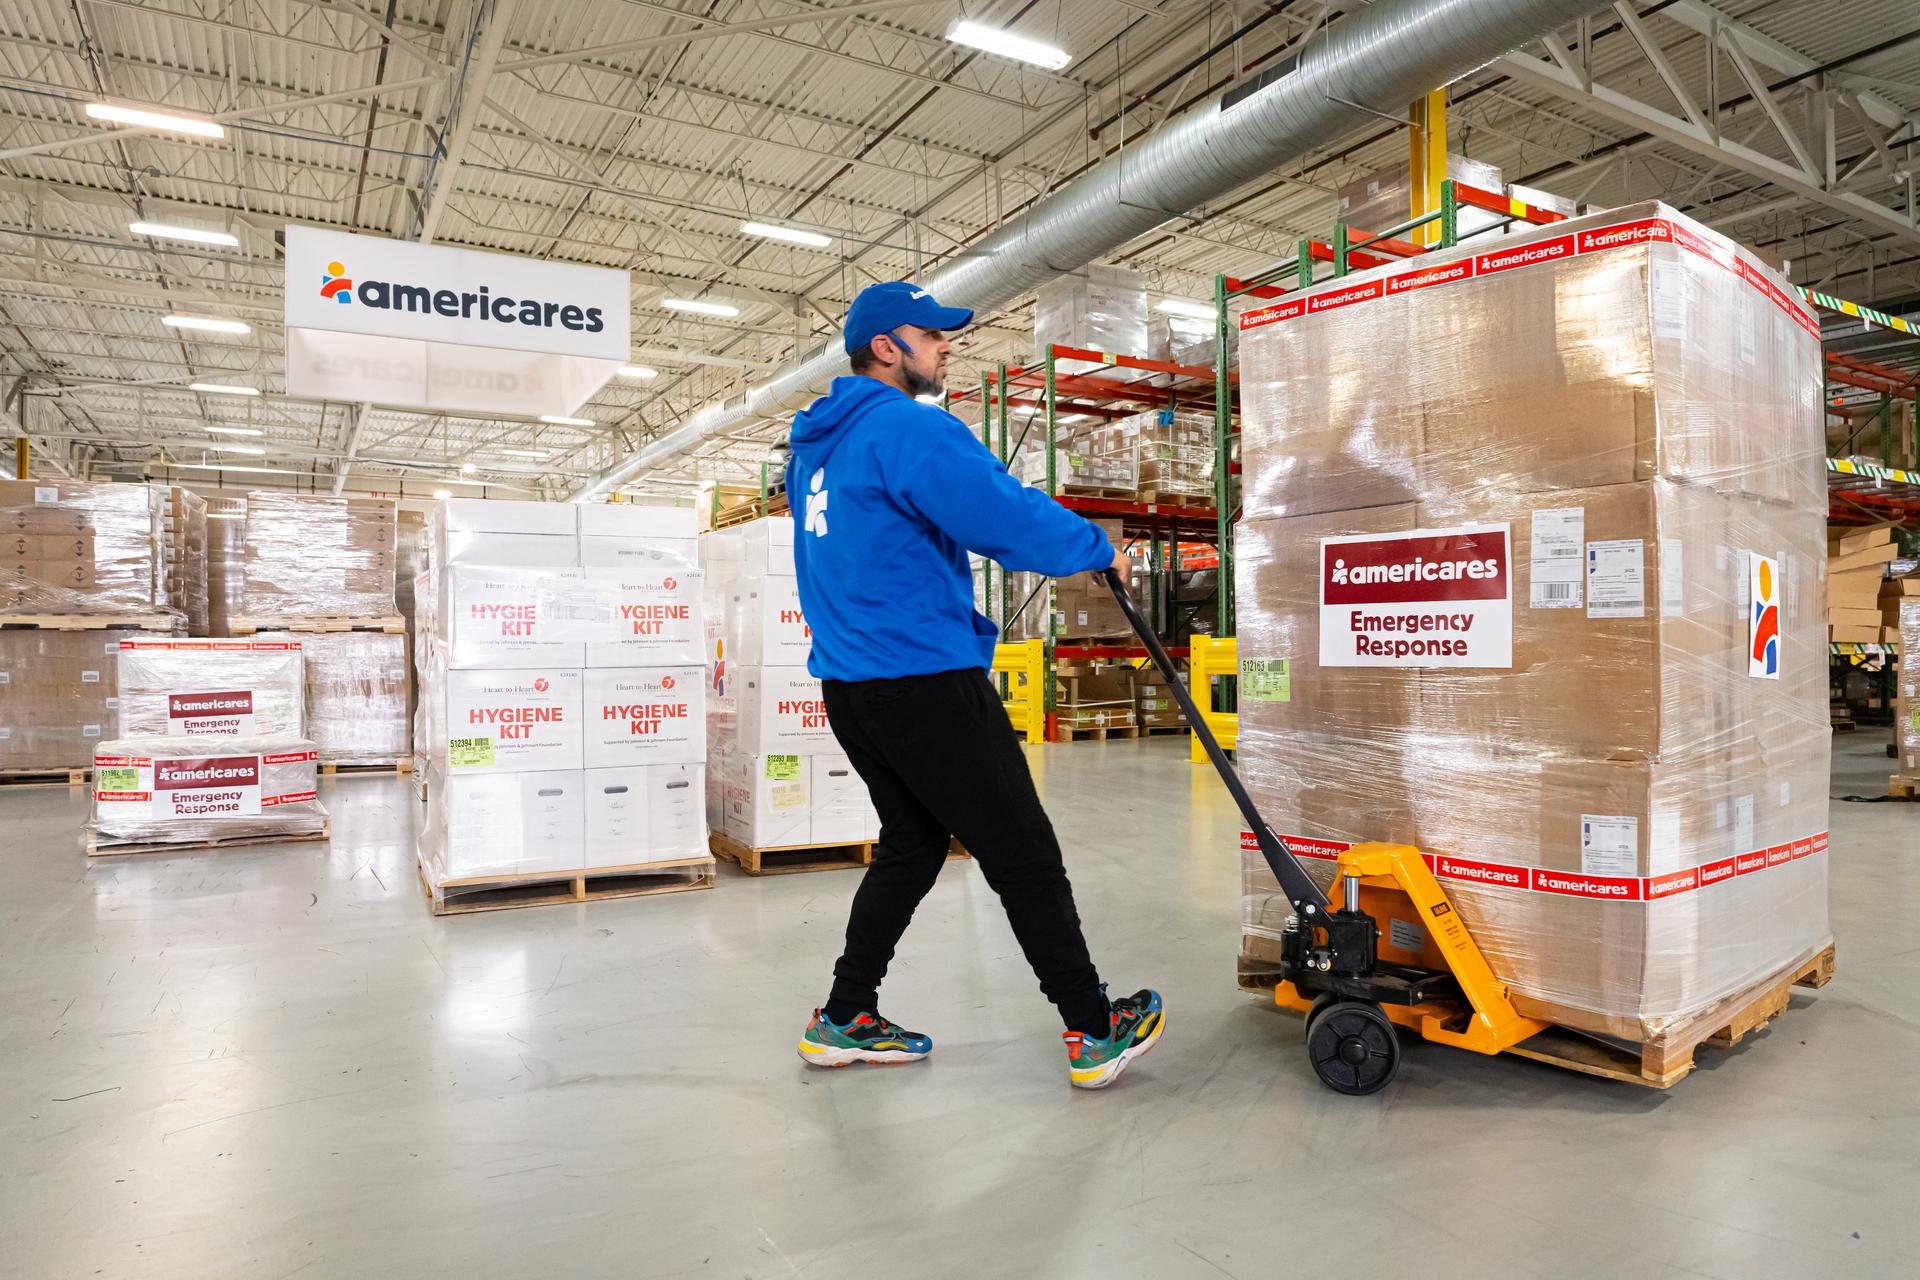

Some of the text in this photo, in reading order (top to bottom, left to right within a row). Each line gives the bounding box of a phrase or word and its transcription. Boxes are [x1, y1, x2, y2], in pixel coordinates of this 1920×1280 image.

[1595, 225, 1667, 246] americares
[1491, 243, 1564, 268] americares
[1400, 265, 1465, 288] americares
[1319, 286, 1376, 307] americares
[357, 280, 604, 333] americares
[1249, 305, 1299, 325] americares
[1159, 411, 1174, 425] 72
[1350, 556, 1498, 585] americares
[502, 621, 536, 636] KIT
[633, 620, 663, 635] KIT
[1351, 611, 1474, 634] Emergency
[1356, 635, 1468, 658] Response
[616, 683, 633, 691] Heart
[182, 699, 249, 711] americares
[603, 703, 688, 720] HYGIENE
[469, 707, 563, 723] HYGIENE
[802, 715, 828, 728] KIT
[184, 719, 241, 729] Emergency
[500, 724, 534, 739] KIT
[631, 720, 661, 735] KIT
[450, 739, 472, 748] 512394
[171, 767, 254, 781] americares
[172, 791, 243, 803] Emergency
[175, 803, 239, 815] Response
[1741, 856, 1765, 870] americares
[1451, 867, 1519, 884] americares
[1707, 865, 1733, 881] americares
[1549, 879, 1628, 895] americares
[1655, 875, 1695, 892] americares
